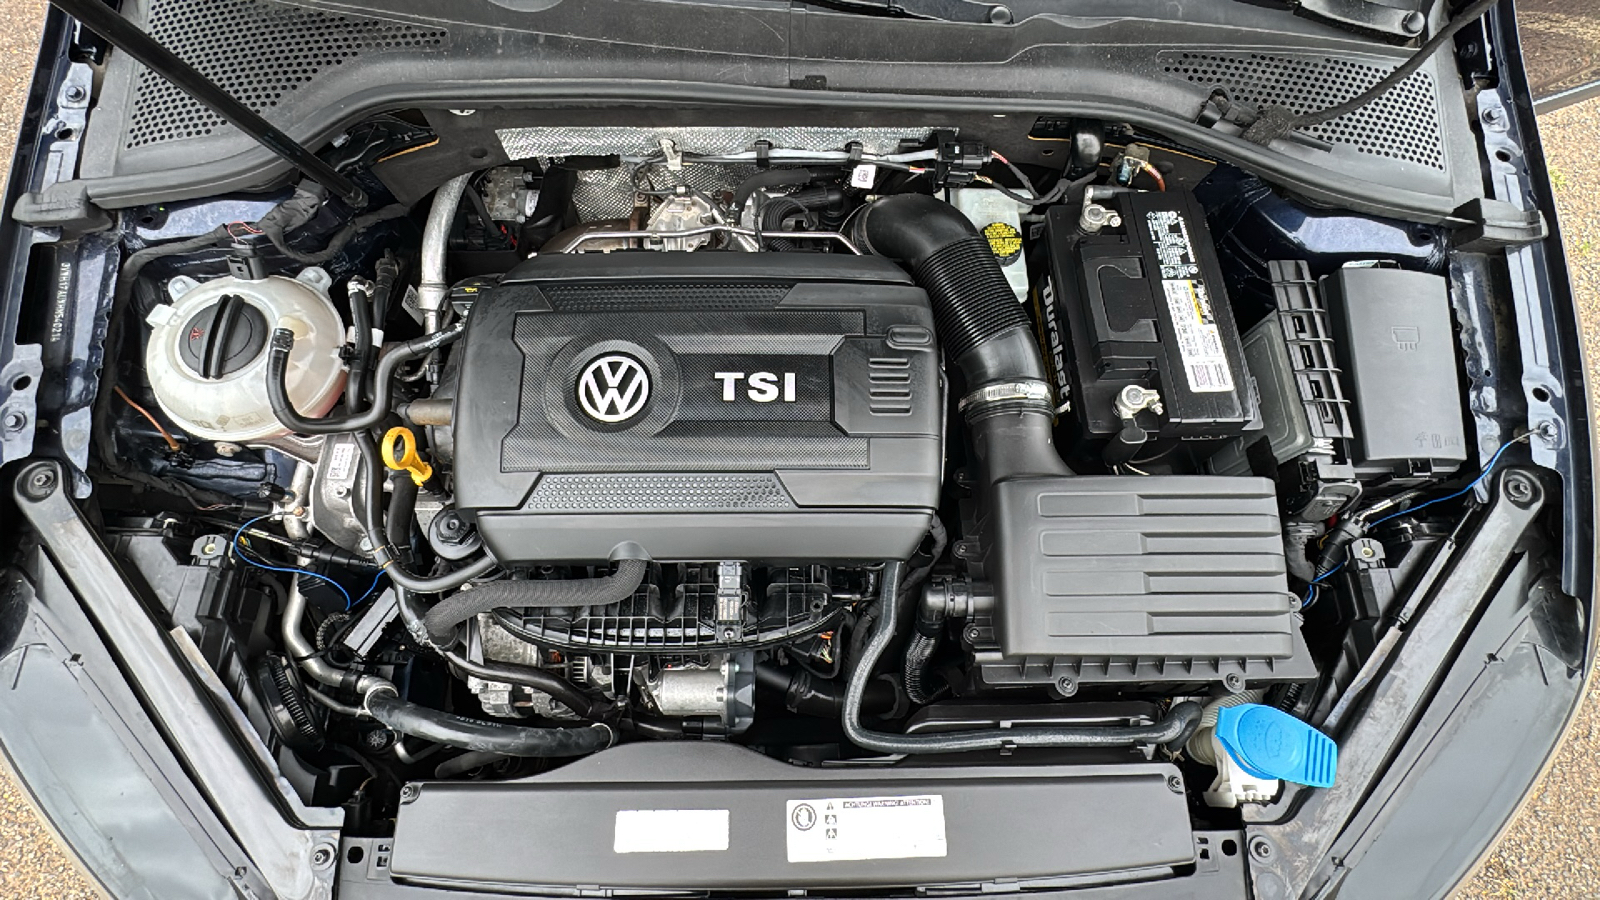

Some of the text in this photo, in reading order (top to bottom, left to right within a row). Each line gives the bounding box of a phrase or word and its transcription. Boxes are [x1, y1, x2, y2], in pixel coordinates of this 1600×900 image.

[1042, 275, 1071, 400] Duralast
[578, 355, 650, 423] VW
[714, 371, 797, 403] TSI
